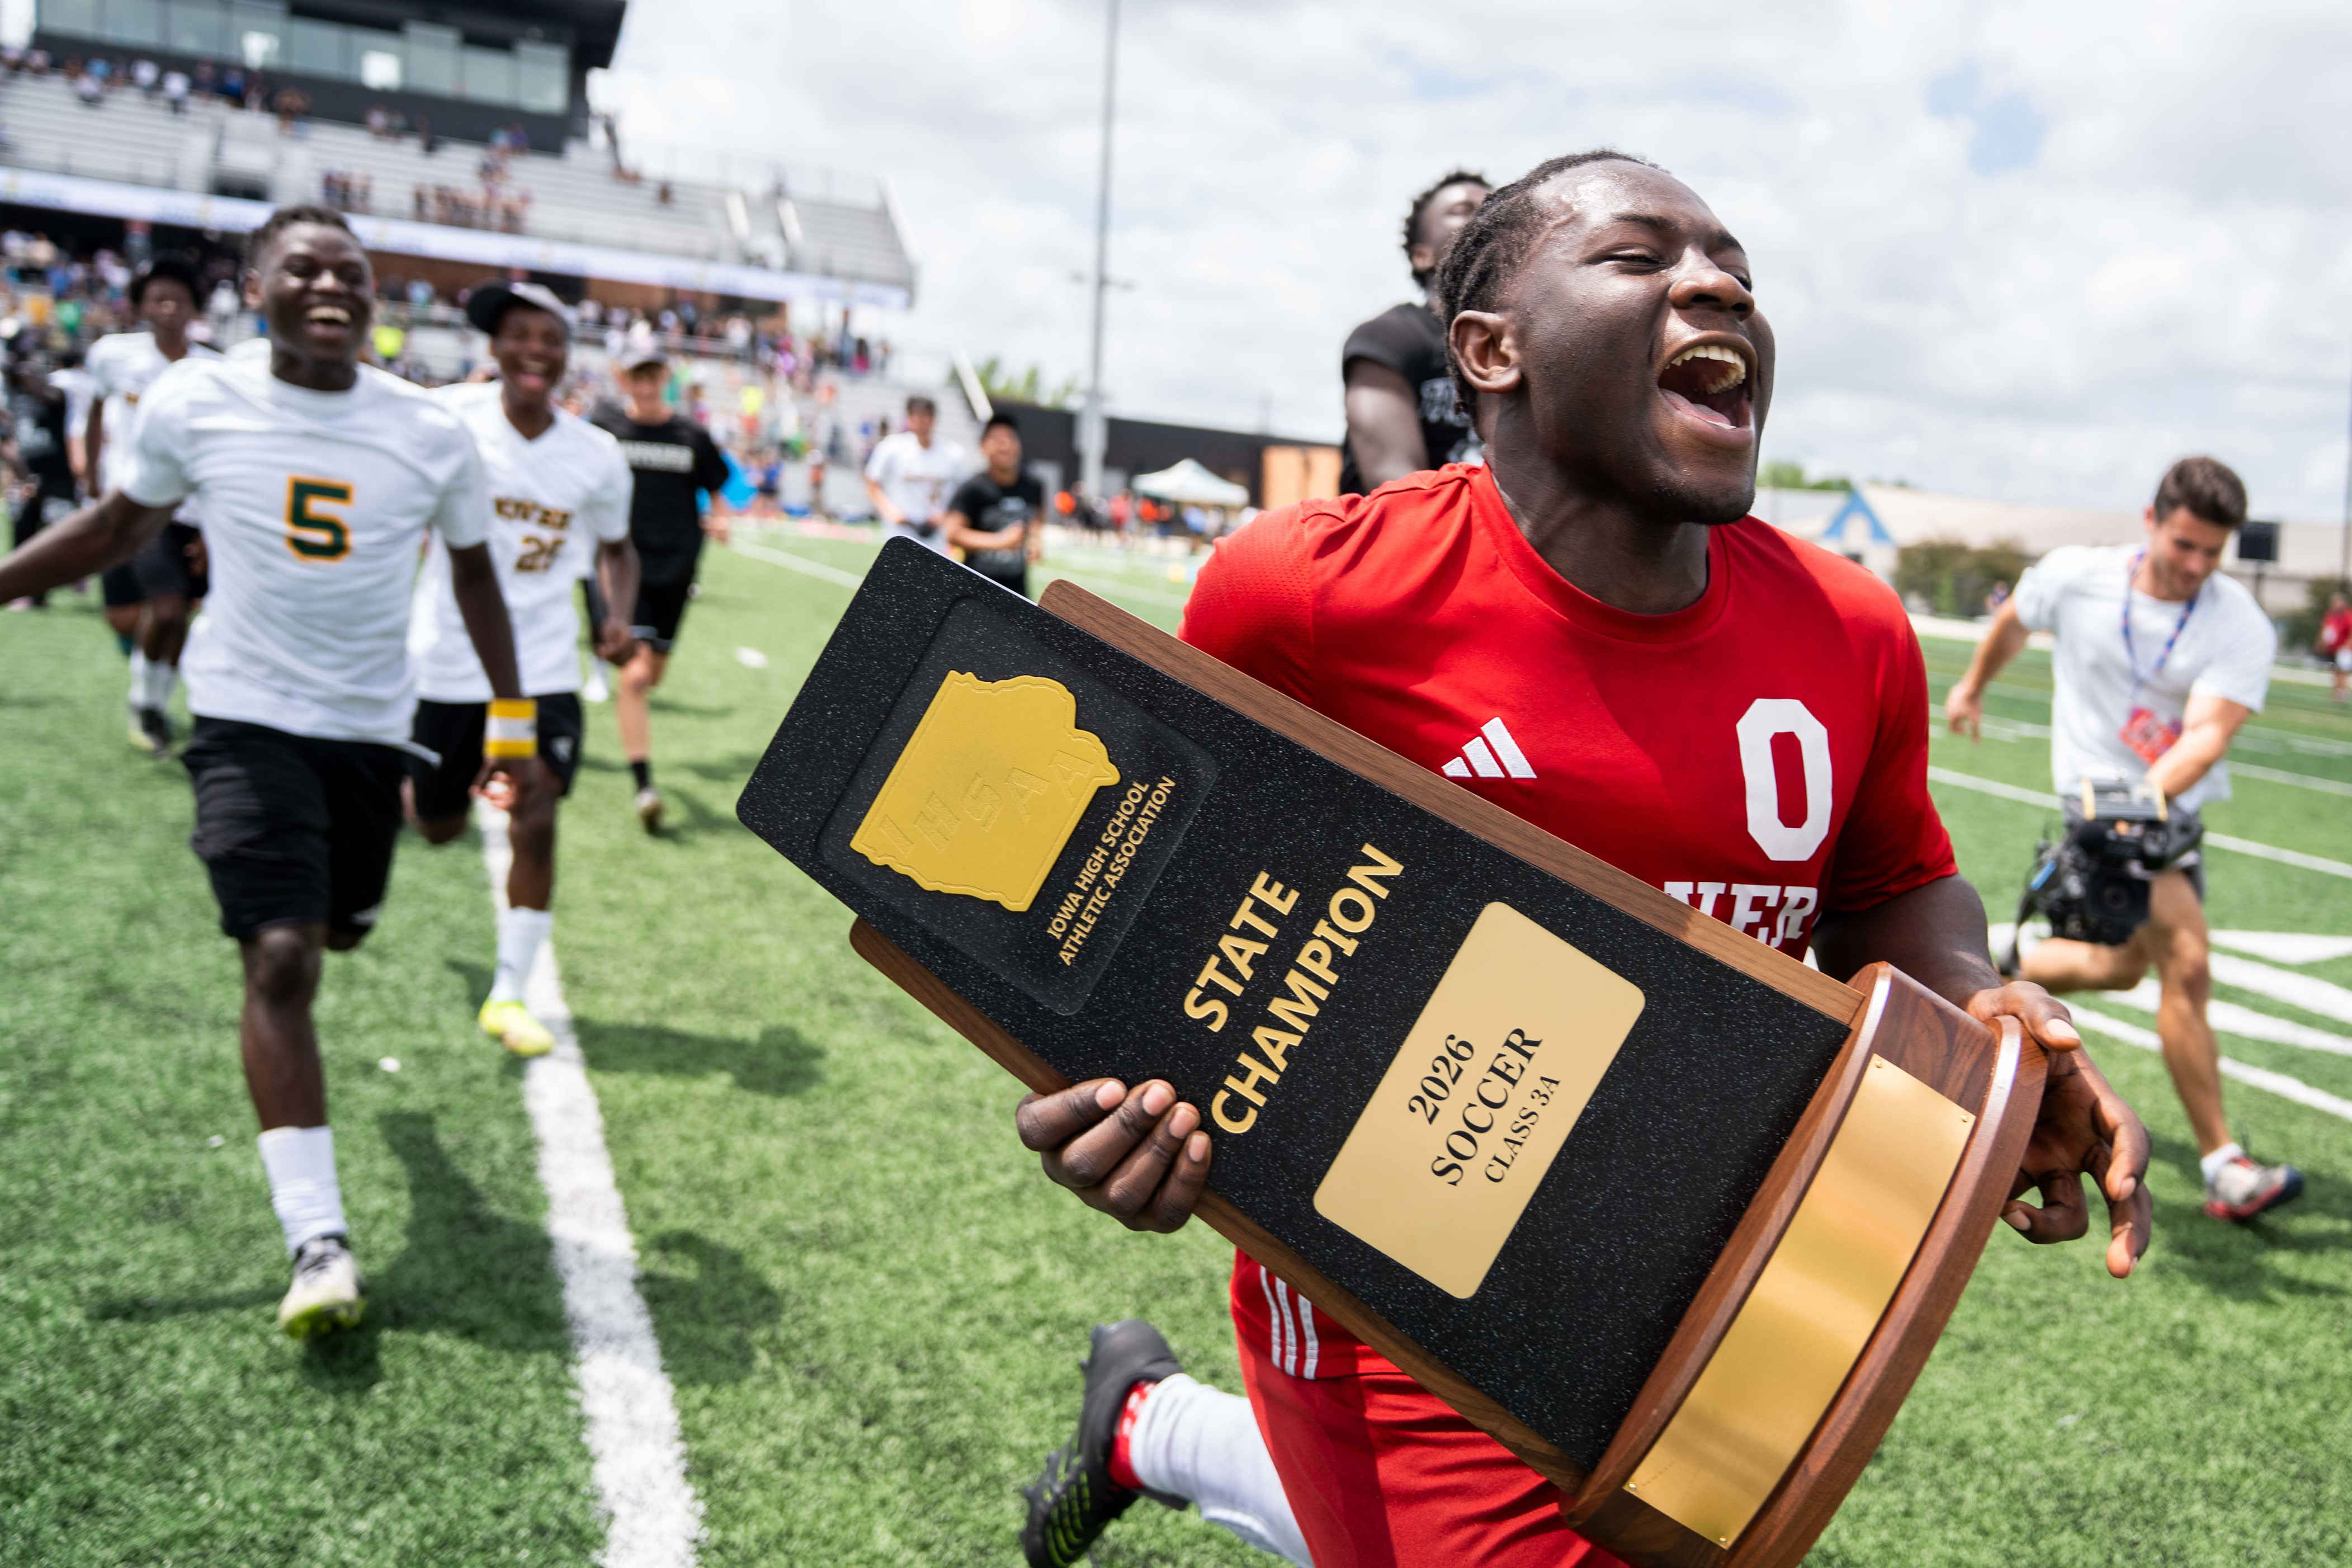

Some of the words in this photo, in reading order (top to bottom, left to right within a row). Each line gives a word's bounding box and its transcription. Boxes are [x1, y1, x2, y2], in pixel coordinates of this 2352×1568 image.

[286, 476, 355, 563] 5
[879, 749, 1094, 856] IHSAA
[1736, 698, 1833, 861] 0
[1047, 892, 1084, 939] IOWA
[1074, 846, 1109, 891] HIGH
[1101, 781, 1150, 847] SCHOOL
[1059, 886, 1111, 966] ATHLETIC
[1103, 776, 1175, 889] ASSOCIATION
[1184, 871, 1300, 1032] STATE
[1211, 843, 1404, 1134] CHAMPION
[1408, 1034, 1474, 1125] 2026
[1431, 1028, 1543, 1187] SOCCER
[1485, 1107, 1539, 1183] CLASS
[1531, 1076, 1561, 1107] 3A
